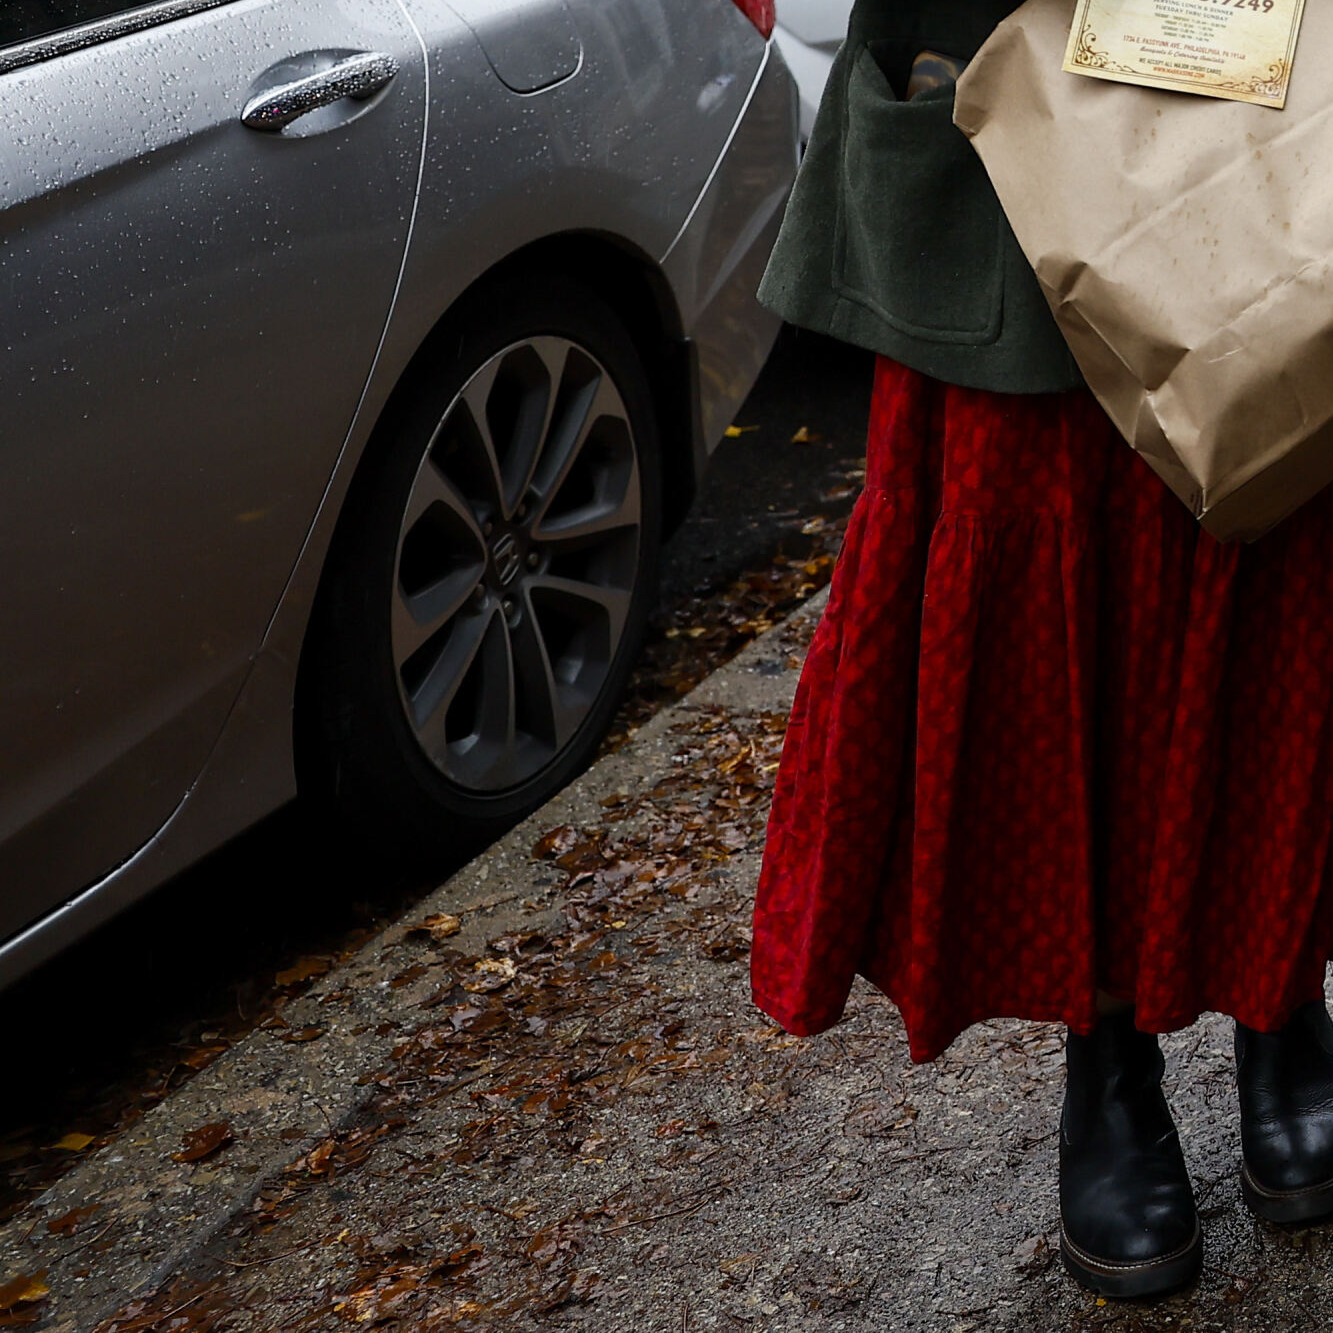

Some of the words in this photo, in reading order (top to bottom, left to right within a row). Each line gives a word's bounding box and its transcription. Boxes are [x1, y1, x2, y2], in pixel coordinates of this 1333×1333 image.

[1156, 4, 1184, 13] TUESDAY
[1203, 13, 1229, 21] SUNDAY
[1181, 2, 1202, 10] LUNCH
[1210, 7, 1234, 16] DINNER
